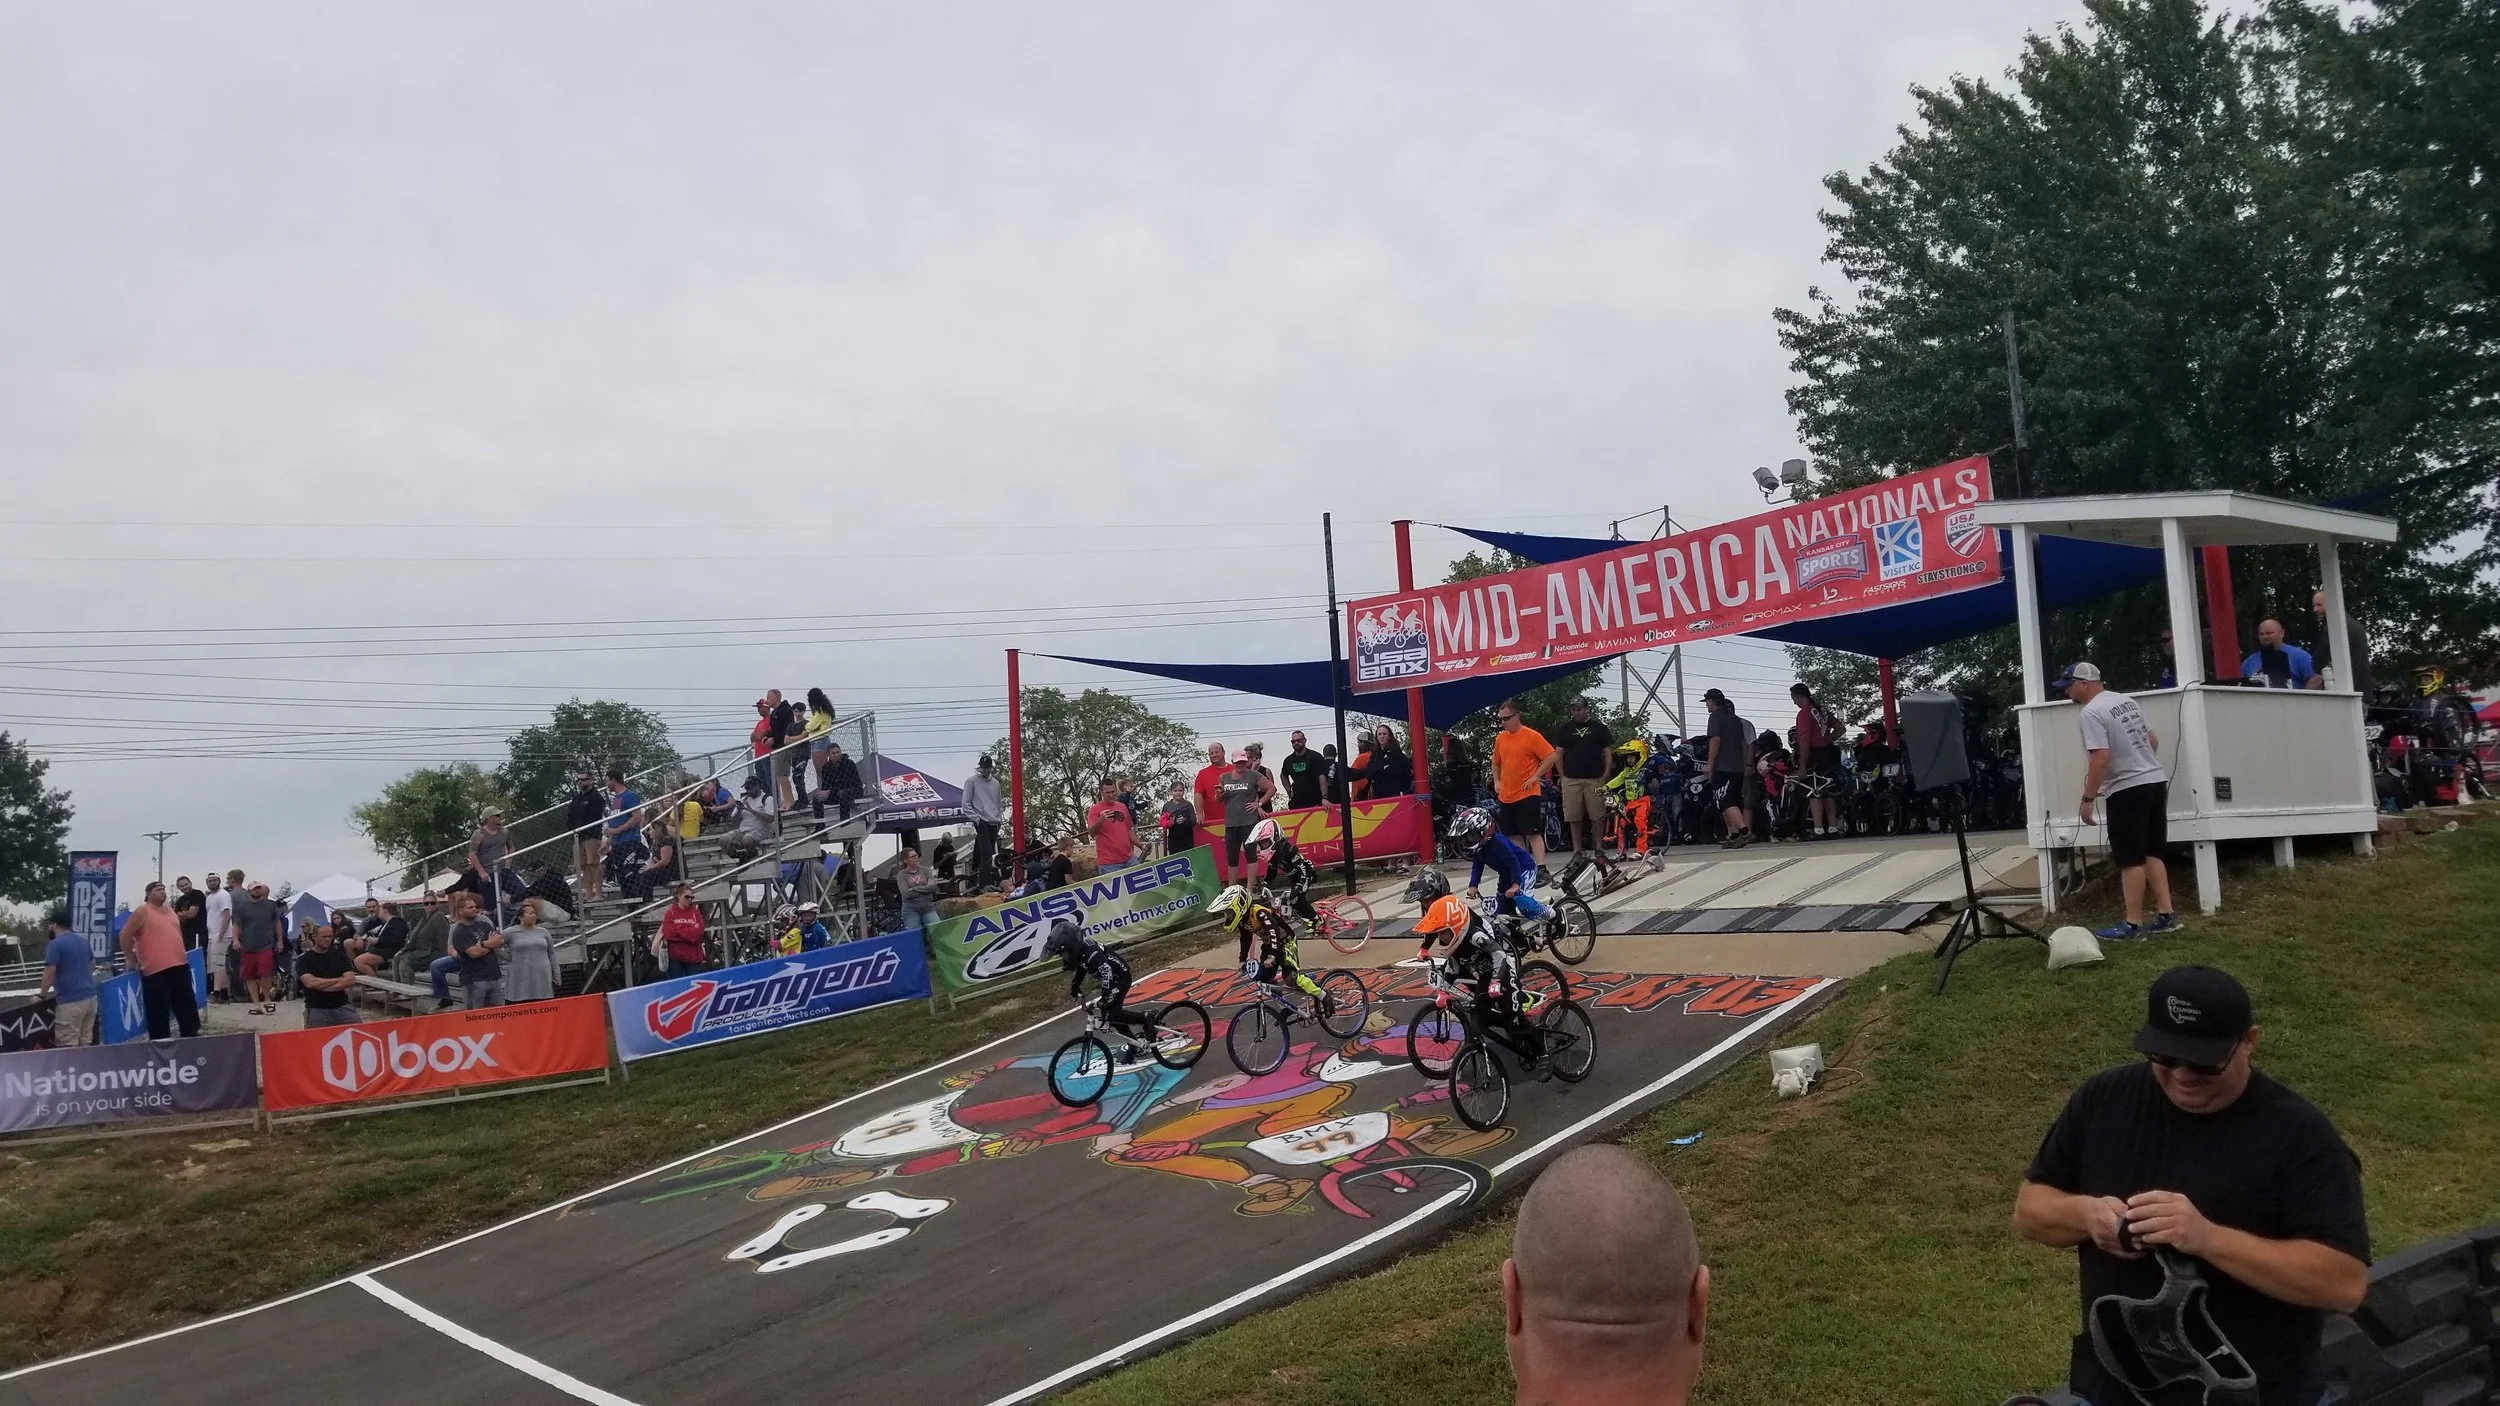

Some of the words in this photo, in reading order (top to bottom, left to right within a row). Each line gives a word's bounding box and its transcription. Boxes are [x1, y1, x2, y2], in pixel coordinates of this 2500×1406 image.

[1784, 467, 1979, 549] NATIONALS
[1950, 522, 1974, 532] CYCLIN
[1806, 545, 1834, 556] KANSAS
[1835, 540, 1850, 550] CITY
[1802, 549, 1860, 577] SPORTS
[1883, 566, 1906, 578] VISIT
[1908, 562, 1921, 572] KC
[1431, 524, 1791, 656] MID-AMERICA
[1360, 660, 1427, 680] BMX
[963, 856, 1194, 944] ANSWER
[1082, 892, 1200, 938] nswerbmx.com
[703, 946, 901, 1019] tangent
[1430, 972, 1438, 986] 54
[465, 1004, 558, 1022] boxcomponents.com
[701, 1008, 784, 1031] PRODUCTS
[728, 1005, 831, 1034] tangentproducts.com
[388, 1030, 499, 1079] box
[4, 1058, 200, 1098] Nationwide
[35, 1101, 50, 1117] is
[56, 1100, 81, 1114] on
[85, 1095, 129, 1114] your
[134, 1091, 173, 1108] side
[1274, 1117, 1355, 1144] BMX
